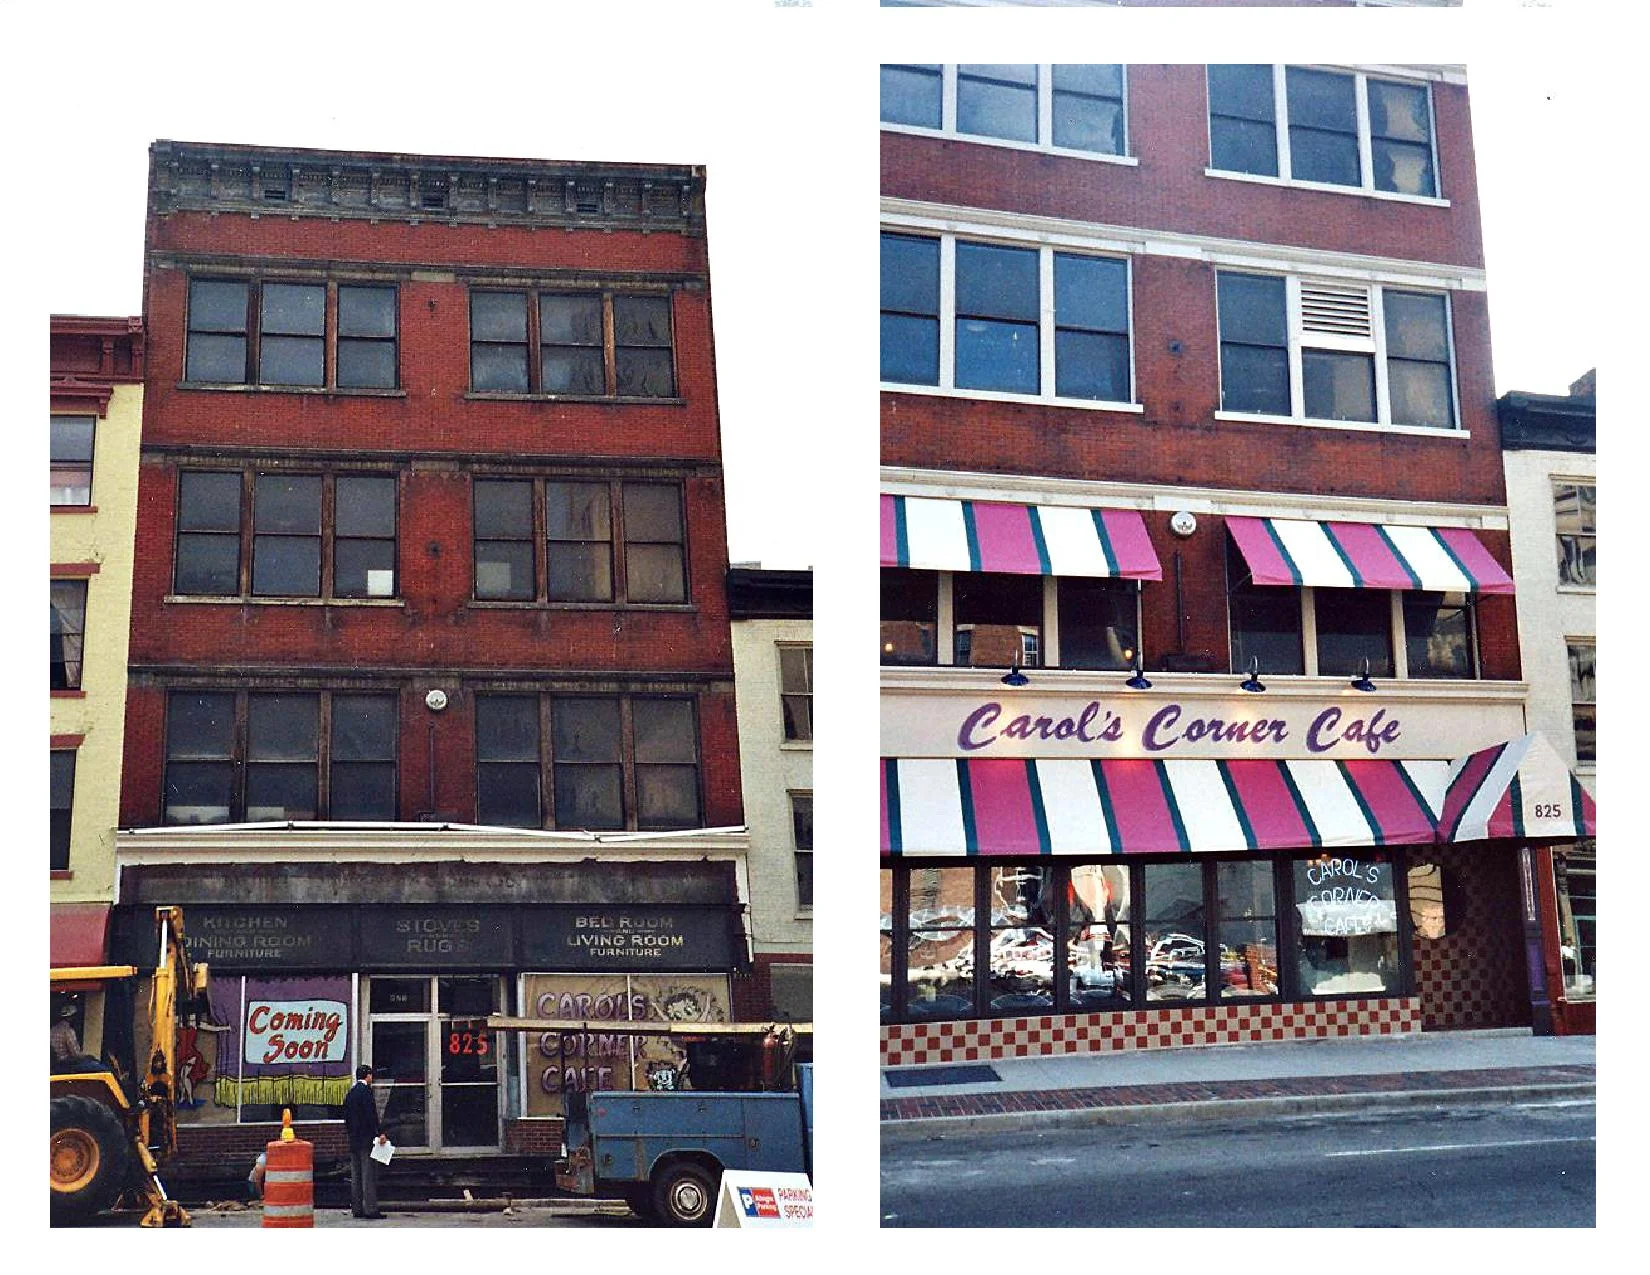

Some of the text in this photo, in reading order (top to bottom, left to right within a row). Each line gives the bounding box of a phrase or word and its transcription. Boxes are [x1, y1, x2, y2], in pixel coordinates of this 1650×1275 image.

[957, 701, 1401, 753] Carol's Corner Cafe
[1534, 804, 1562, 818] 825
[1307, 858, 1380, 885] CAROL'S
[202, 916, 289, 929] KITCHEN
[619, 916, 674, 928] ROOM
[253, 935, 314, 948] ROOM
[566, 934, 684, 947] LIVING ROOM
[206, 948, 282, 959] FURNITURE
[589, 948, 663, 957] FURNITURE
[248, 1005, 344, 1043] Coming
[262, 1033, 329, 1065] Soon
[449, 1032, 489, 1056] 825
[539, 1031, 649, 1060] CORNER
